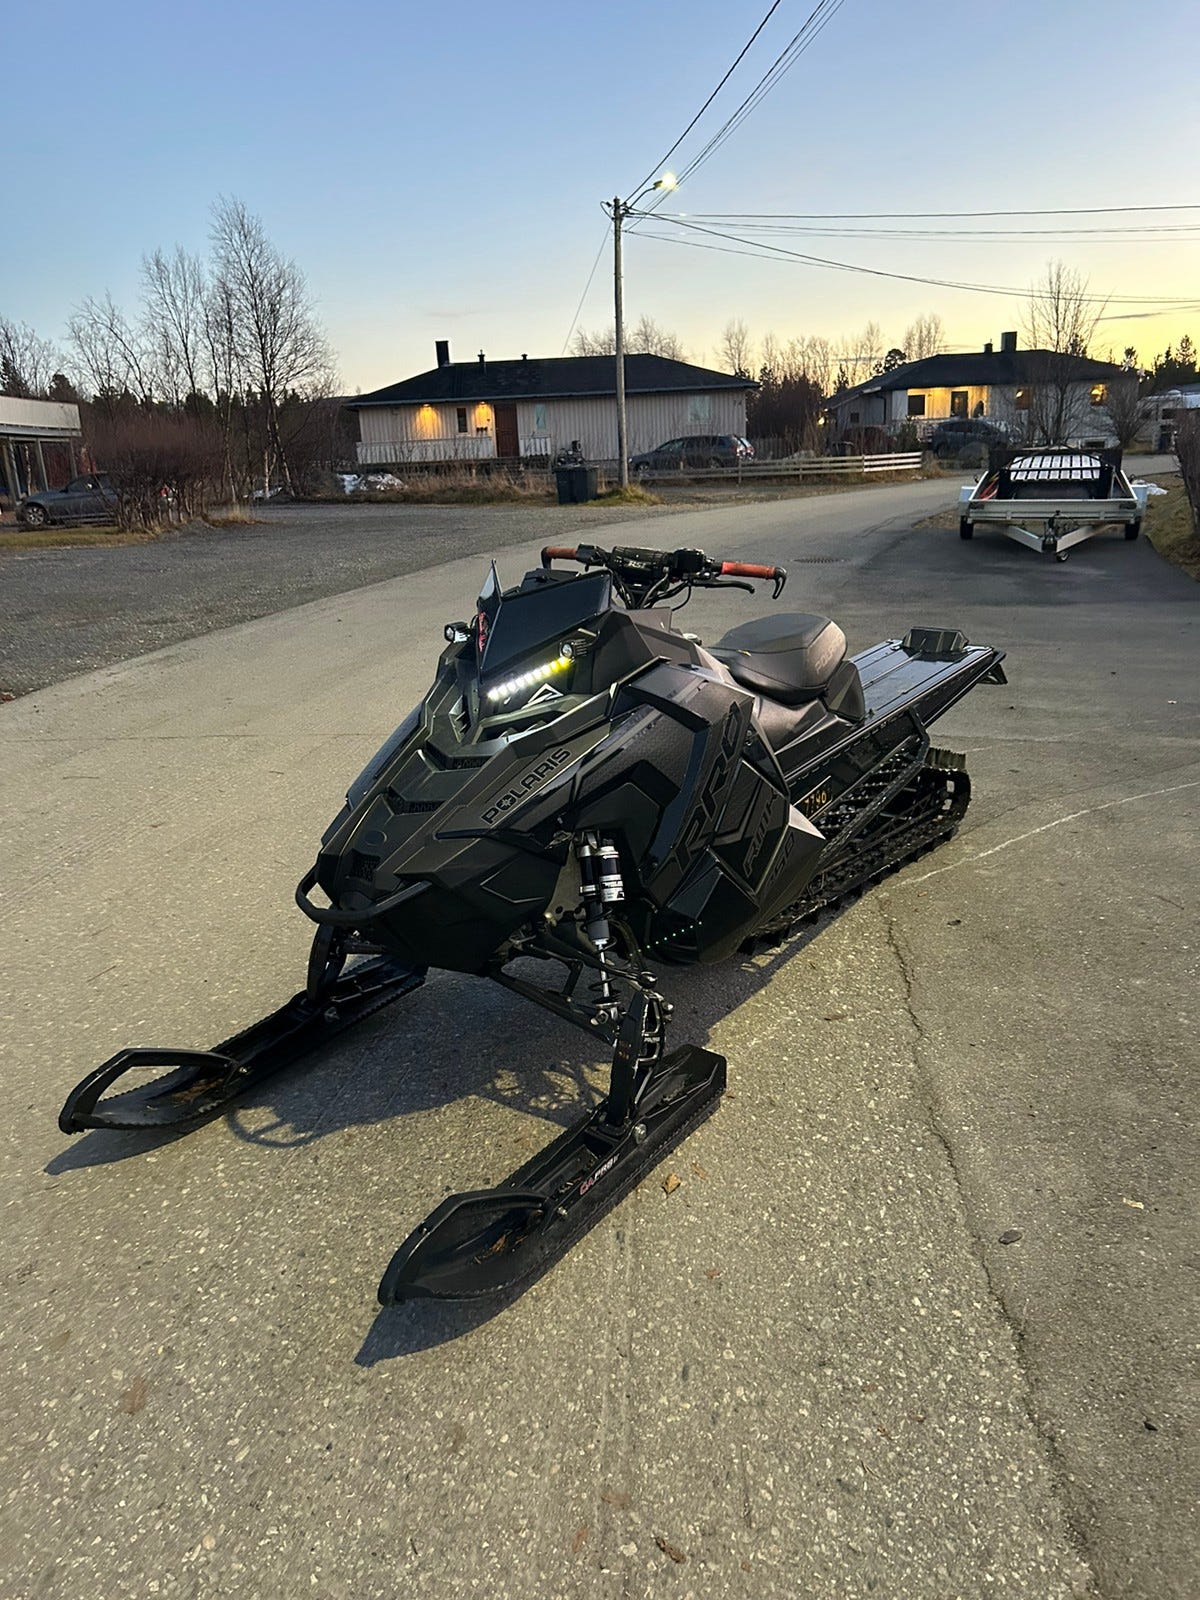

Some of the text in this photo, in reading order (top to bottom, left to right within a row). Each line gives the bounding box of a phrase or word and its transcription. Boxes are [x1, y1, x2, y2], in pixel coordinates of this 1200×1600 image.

[481, 748, 571, 824] POLARIS
[674, 701, 743, 875] PRO
[768, 831, 795, 888] 50
